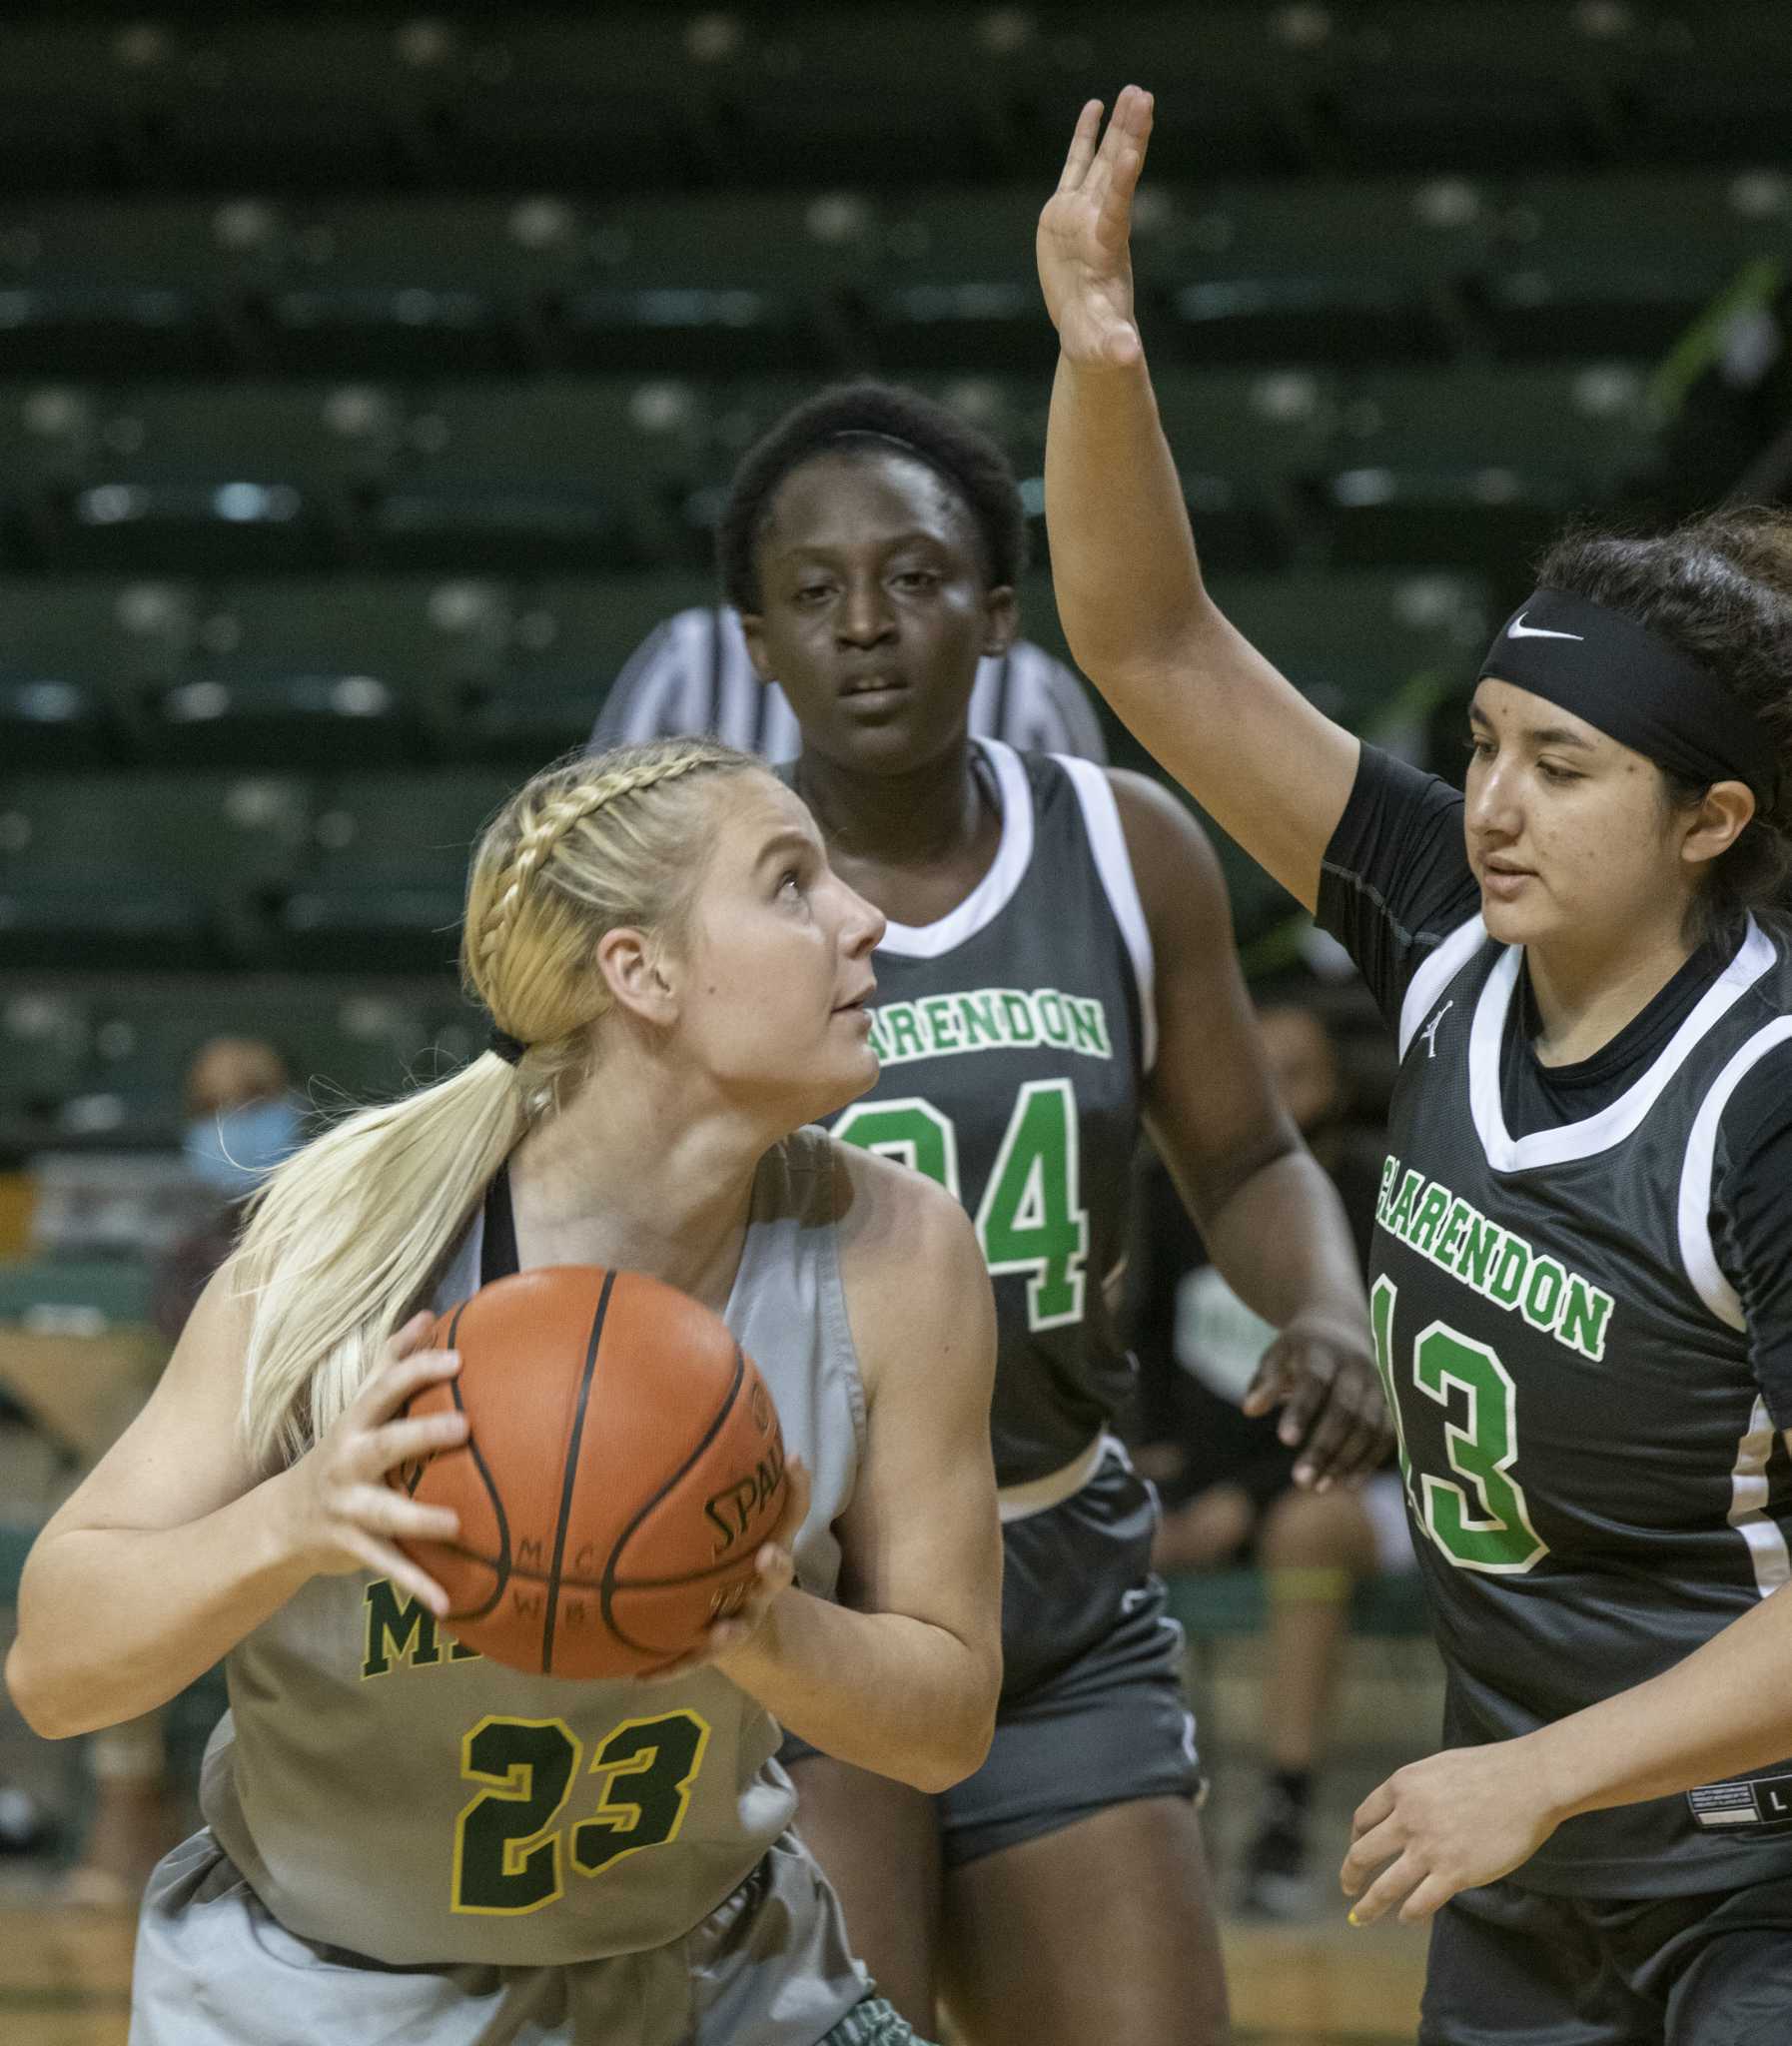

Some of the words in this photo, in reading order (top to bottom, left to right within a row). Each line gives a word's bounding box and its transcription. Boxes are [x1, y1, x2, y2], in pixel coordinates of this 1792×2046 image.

[864, 988, 1113, 1068] ARENDON
[1370, 1273, 1550, 1574] 13
[361, 1577, 483, 1681] M
[450, 1708, 711, 1916] 23
[1769, 1791, 1788, 1811] L
